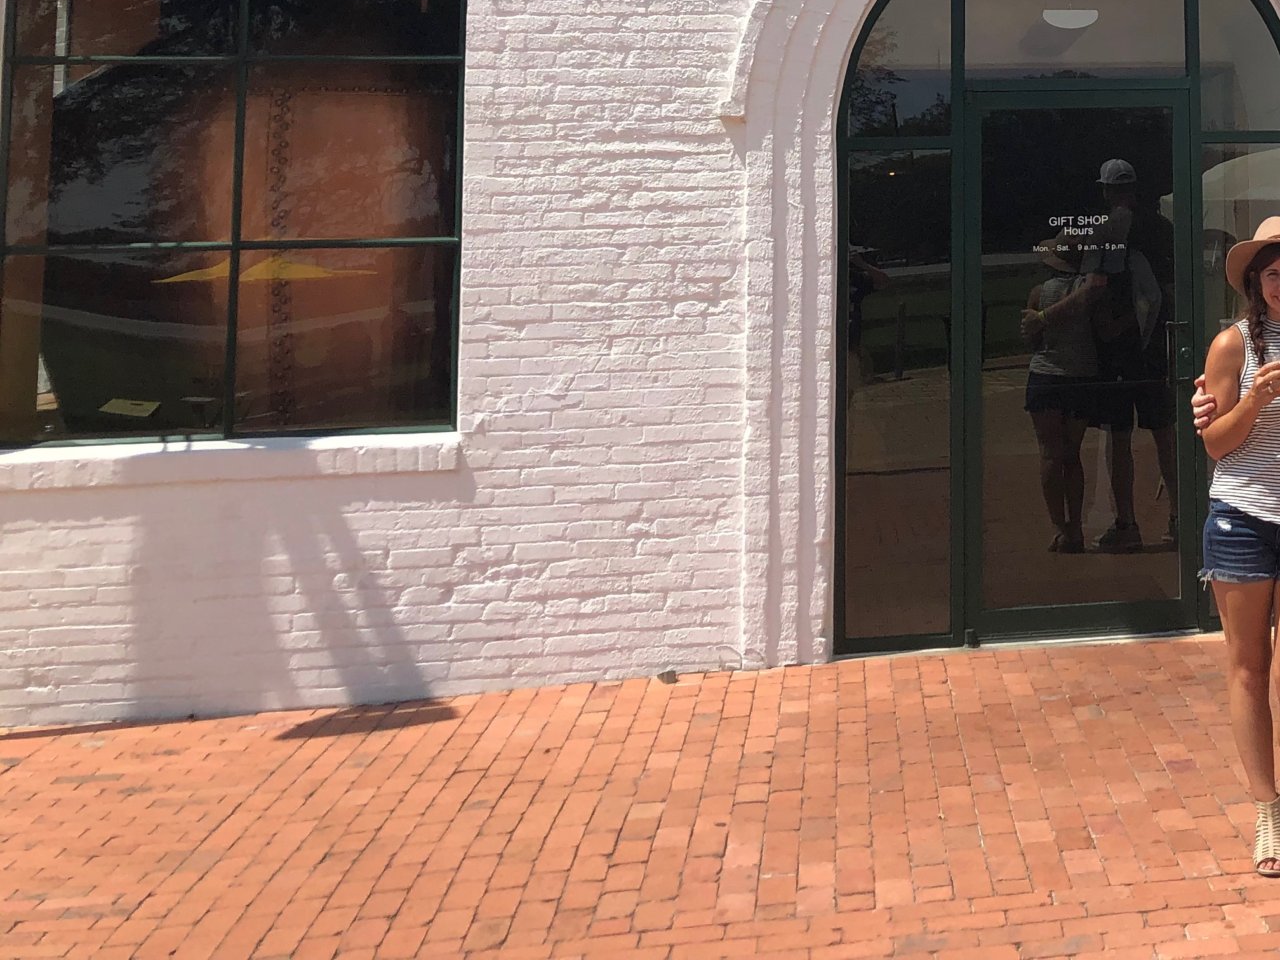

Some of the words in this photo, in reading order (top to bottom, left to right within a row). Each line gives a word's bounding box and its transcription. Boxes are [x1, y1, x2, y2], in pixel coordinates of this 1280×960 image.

[1048, 216, 1075, 227] GIFT
[1077, 215, 1109, 225] SHOP
[1064, 226, 1094, 236] Hours
[1056, 244, 1071, 252] Sat.
